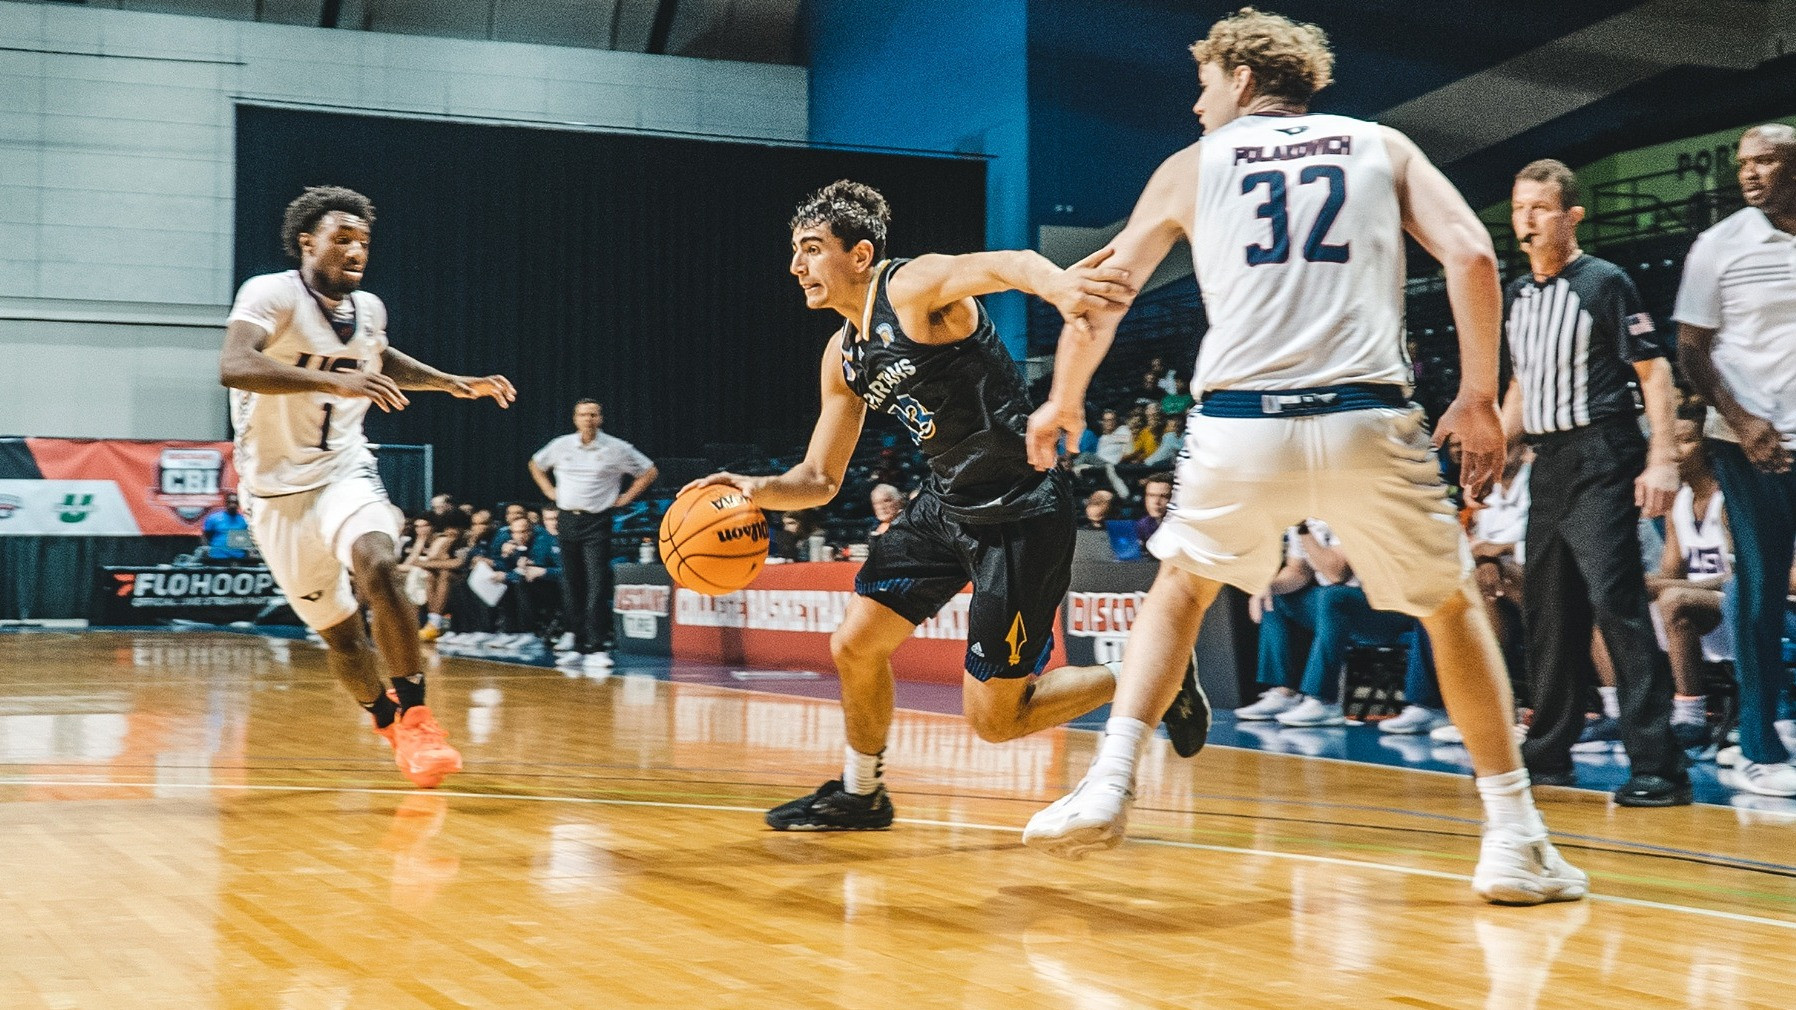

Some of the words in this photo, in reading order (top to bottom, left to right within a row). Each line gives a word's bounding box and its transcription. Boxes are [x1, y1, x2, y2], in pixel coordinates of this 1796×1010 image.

[1676, 143, 1740, 180] POR
[1240, 164, 1350, 267] 32
[317, 402, 335, 451] 1
